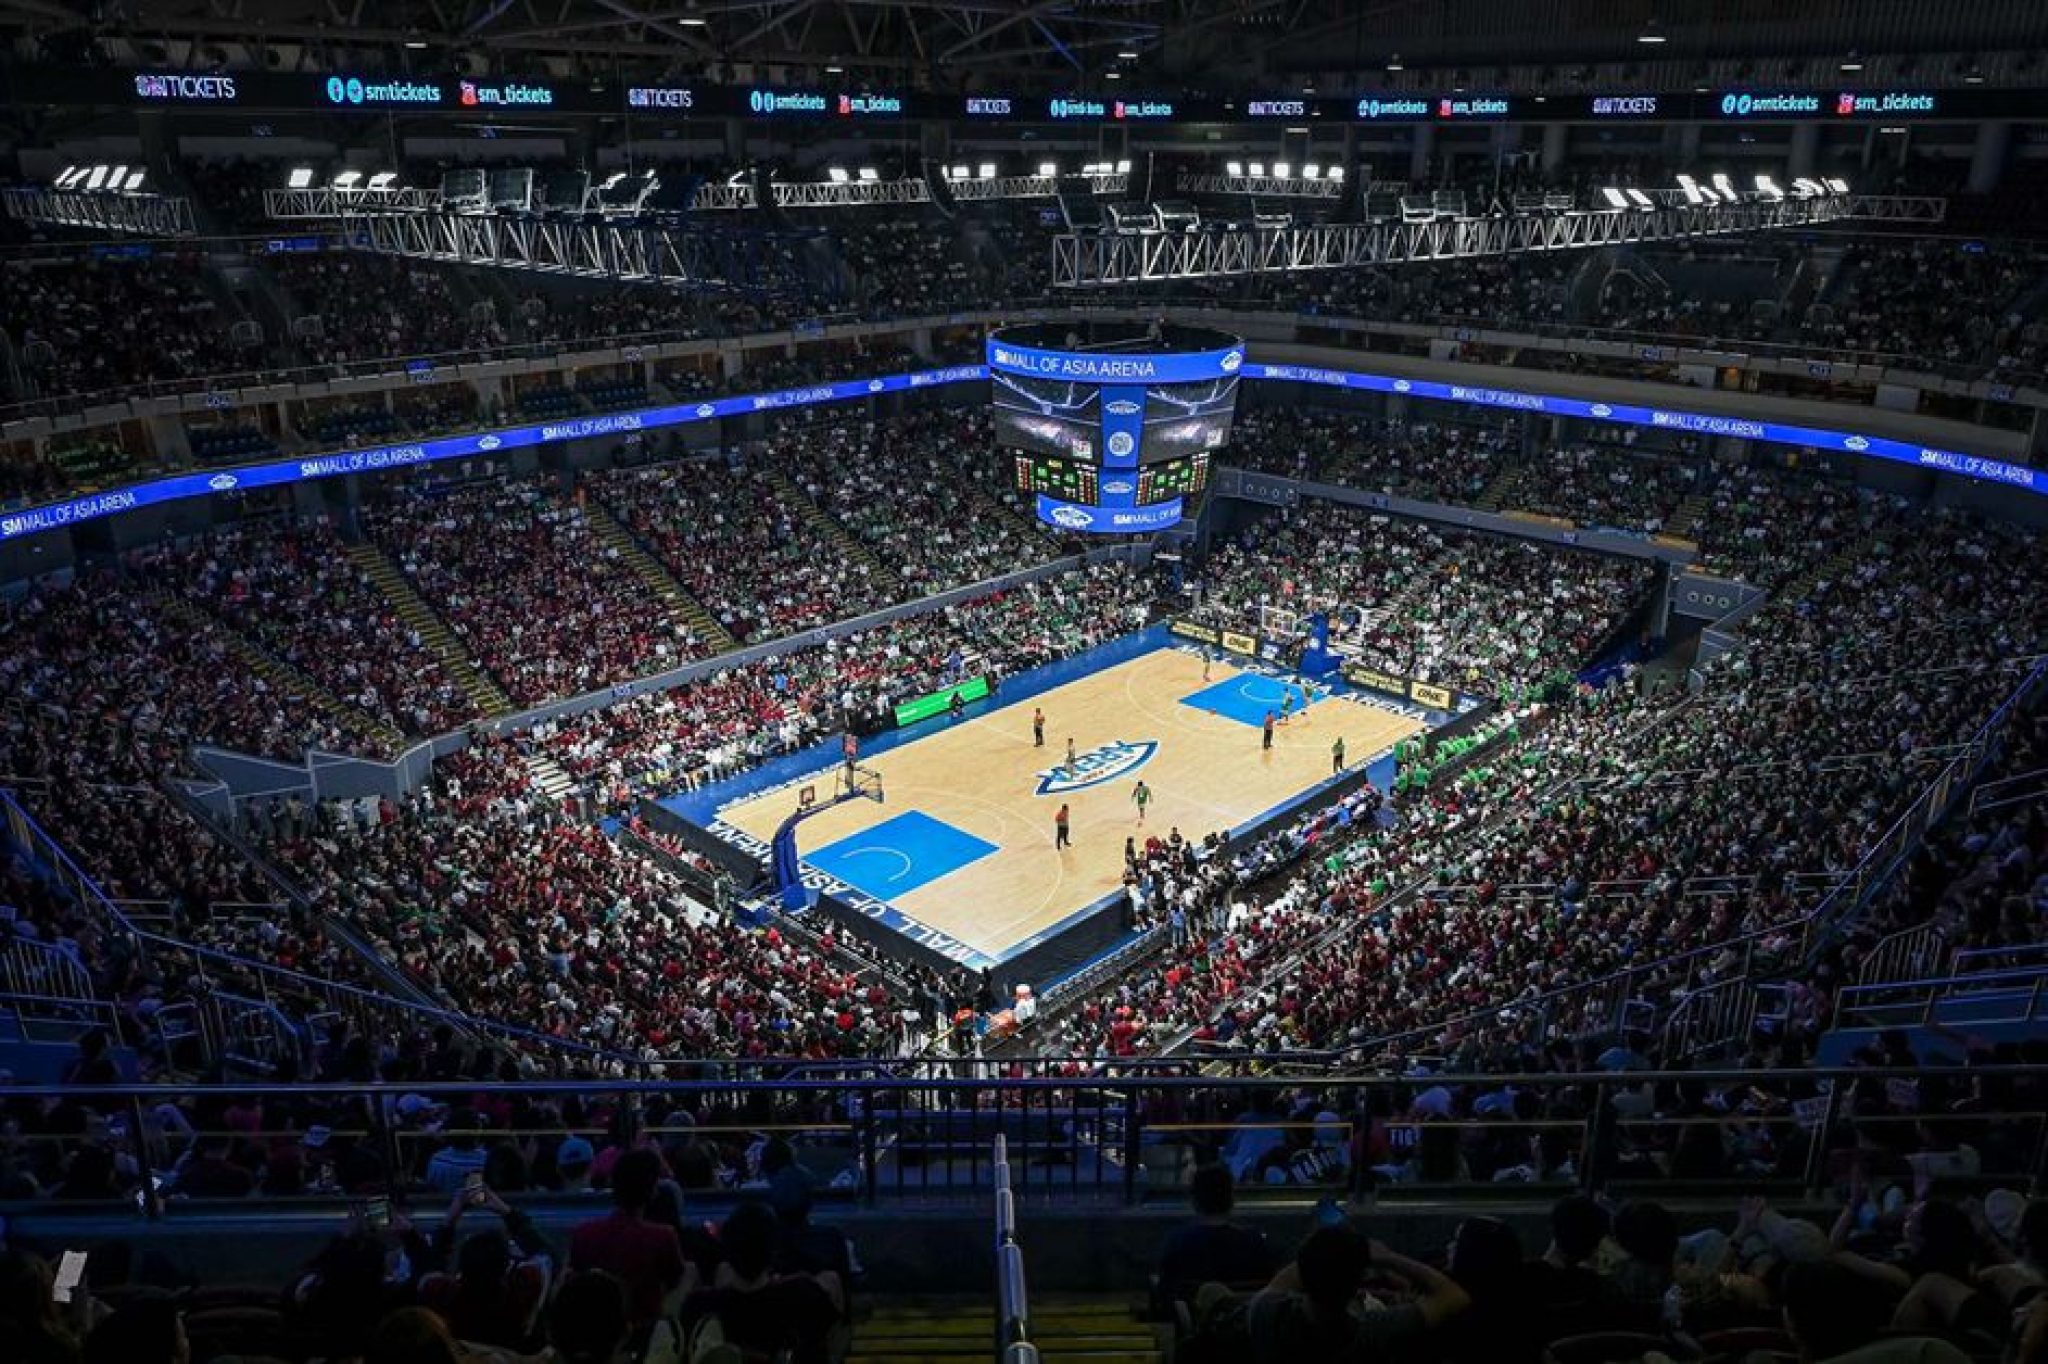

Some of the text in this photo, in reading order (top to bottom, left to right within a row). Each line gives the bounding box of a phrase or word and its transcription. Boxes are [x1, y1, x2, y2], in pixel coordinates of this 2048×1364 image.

[166, 76, 235, 98] TICKETS
[365, 79, 441, 101] smtickets
[477, 84, 552, 105] sm_tickets
[1854, 93, 1934, 112] sm_tickets
[1040, 358, 1060, 372] OF
[1062, 360, 1097, 375] ASIA
[1099, 361, 1156, 376] ARENA
[350, 454, 365, 470] OF
[21, 510, 55, 532] MALL
[56, 504, 72, 523] OF
[73, 499, 99, 520] ASIA
[99, 491, 136, 514] ARENA
